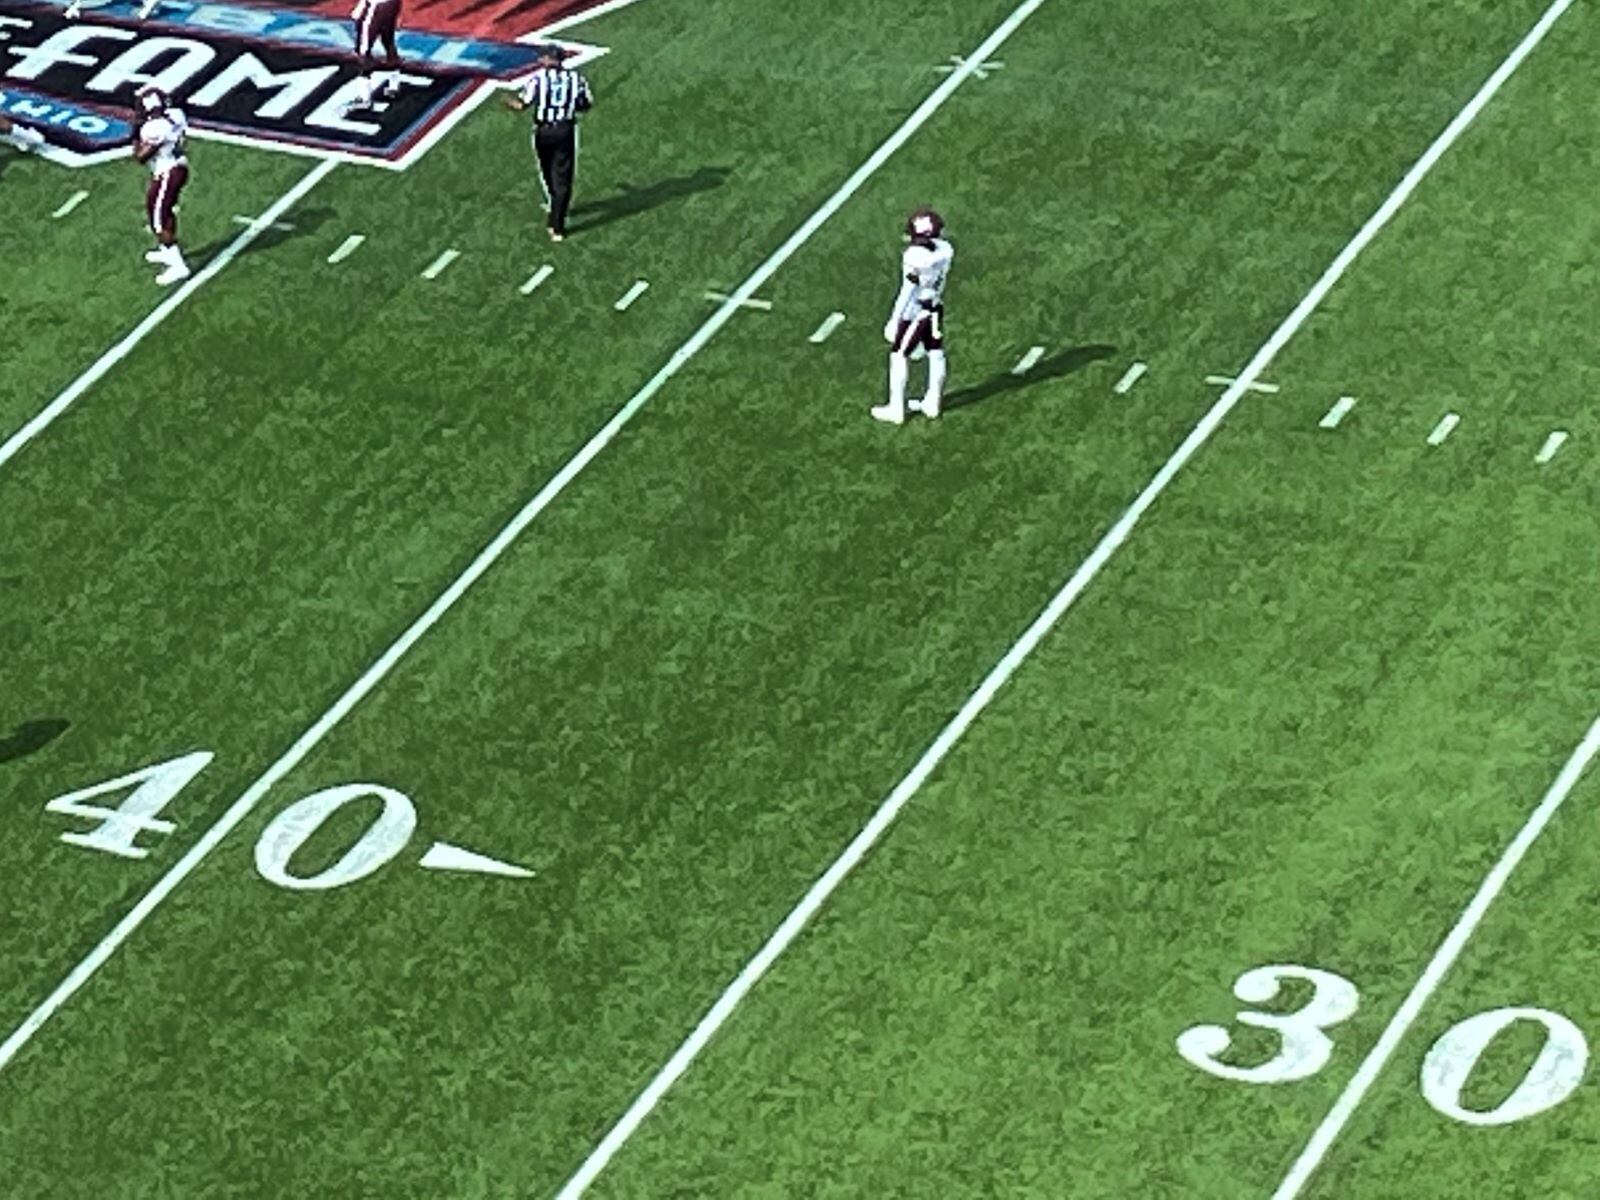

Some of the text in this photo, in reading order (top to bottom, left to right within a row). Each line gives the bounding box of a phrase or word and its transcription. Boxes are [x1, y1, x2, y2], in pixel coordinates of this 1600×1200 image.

[4, 24, 434, 134] FAME
[45, 750, 418, 890] 40
[1175, 964, 1591, 1127] 30
